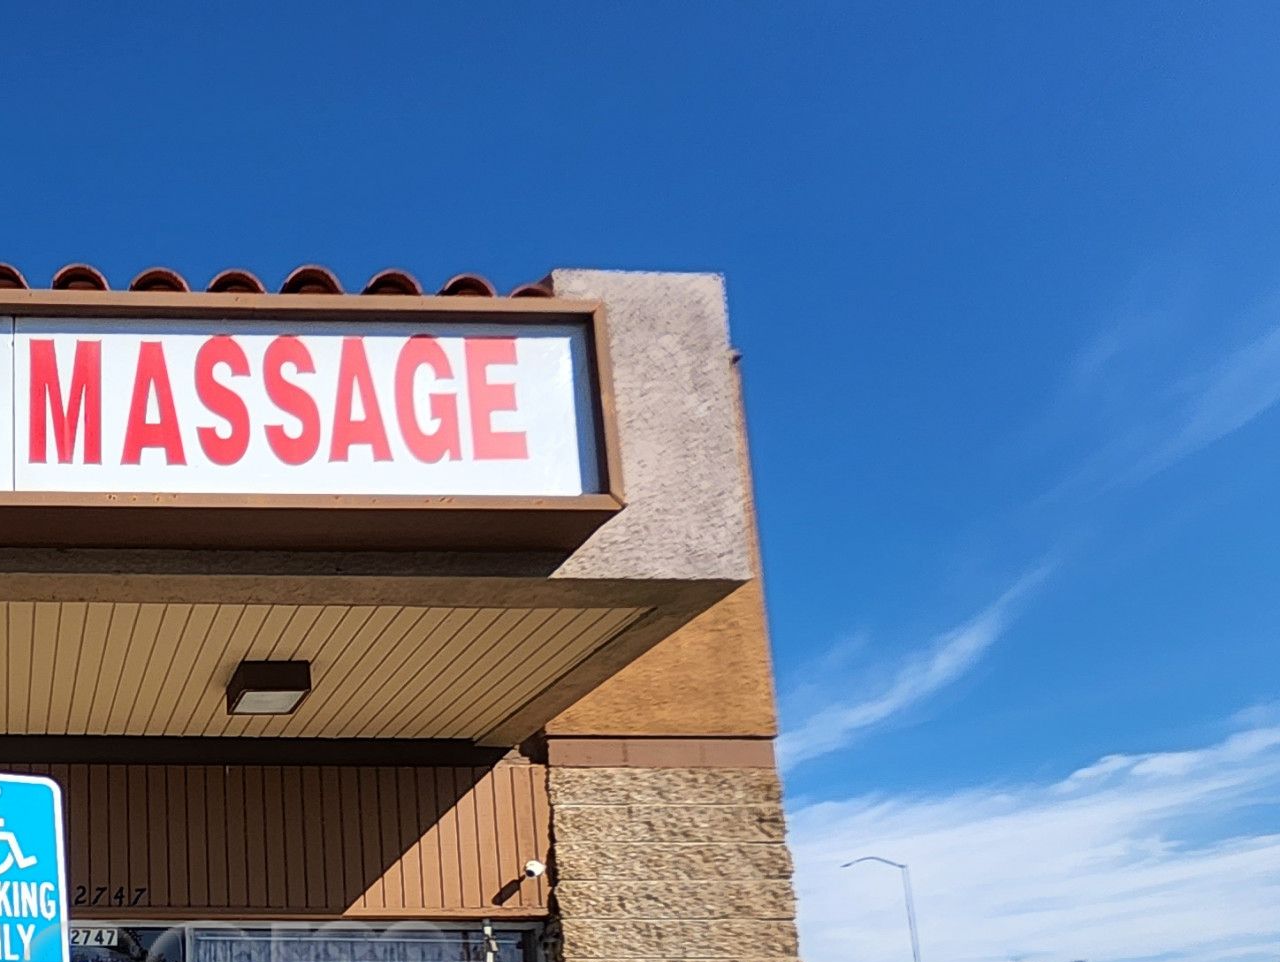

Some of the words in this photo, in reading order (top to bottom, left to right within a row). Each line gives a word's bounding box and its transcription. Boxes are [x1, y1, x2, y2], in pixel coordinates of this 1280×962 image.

[28, 334, 529, 466] MASSAGE
[74, 886, 147, 906] 2747
[71, 930, 116, 945] 2747
